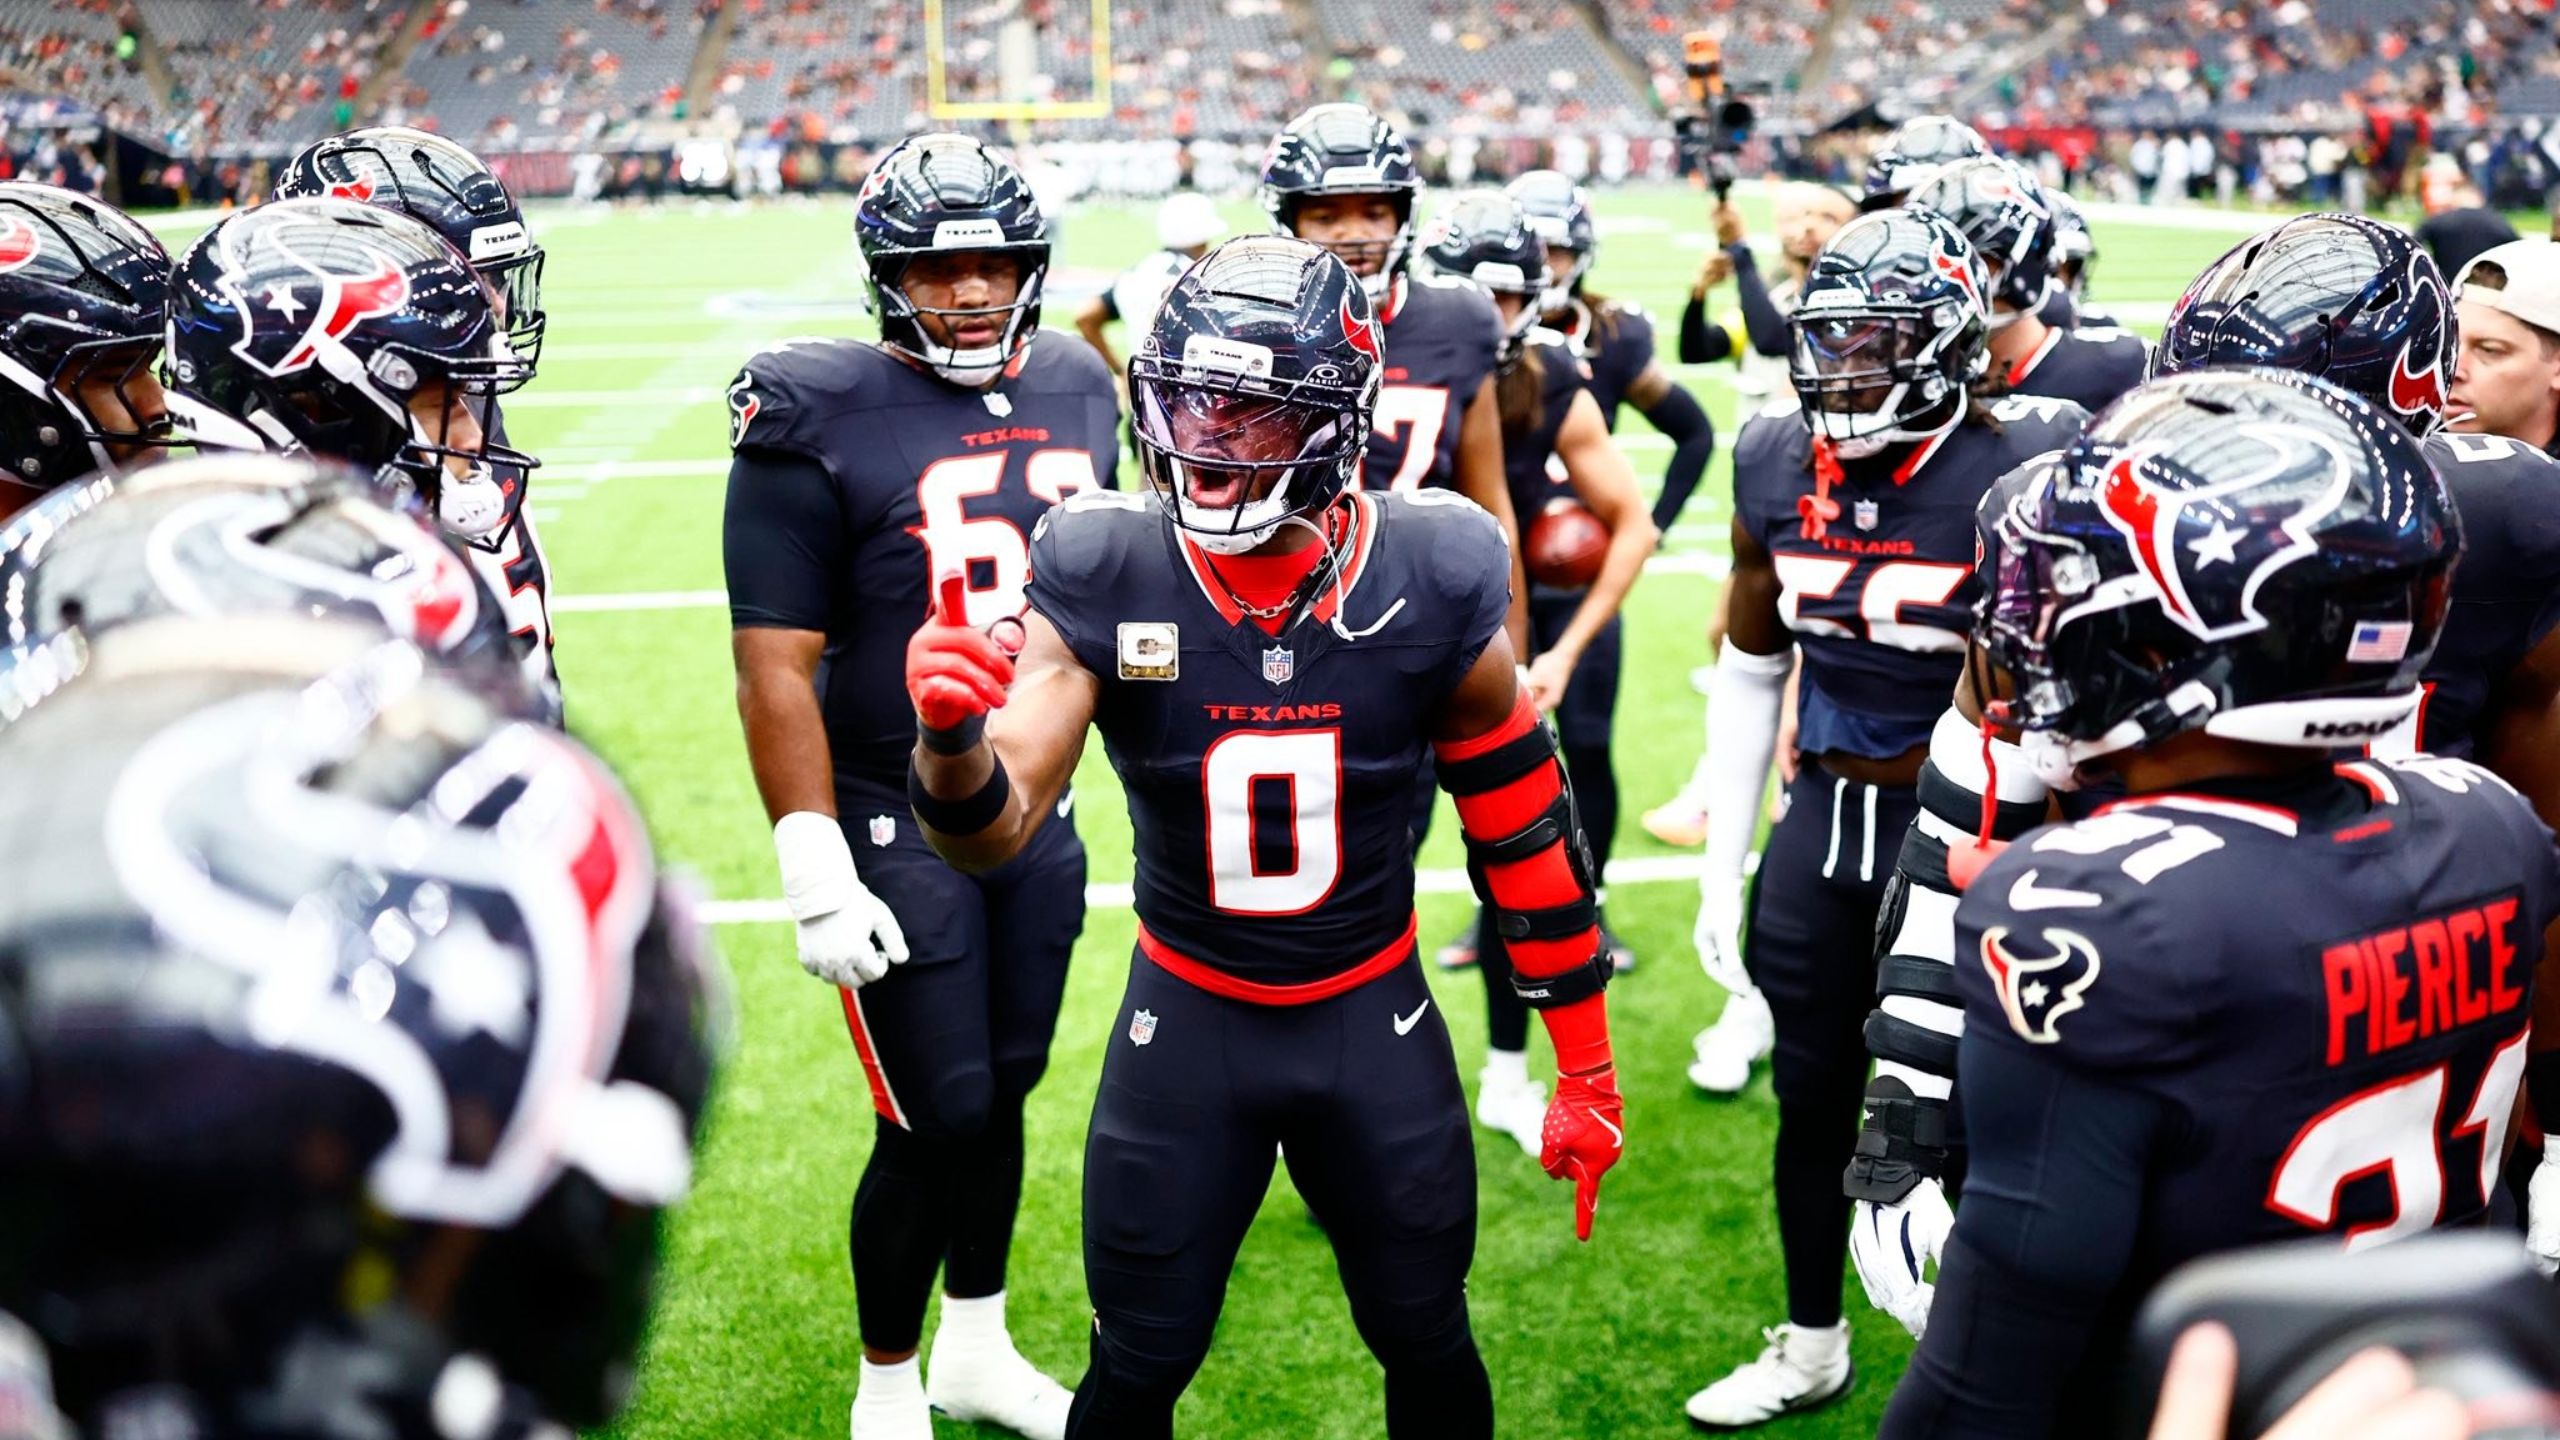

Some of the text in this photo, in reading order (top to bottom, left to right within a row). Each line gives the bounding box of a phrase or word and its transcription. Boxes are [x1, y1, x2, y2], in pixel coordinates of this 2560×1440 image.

[960, 427, 1051, 447] TEXANS
[1121, 626, 1174, 668] C
[1267, 663, 1289, 677] NFL
[1203, 703, 1342, 722] TEXANS
[1201, 727, 1343, 916] 0
[2322, 897, 2523, 1068] PIERCE
